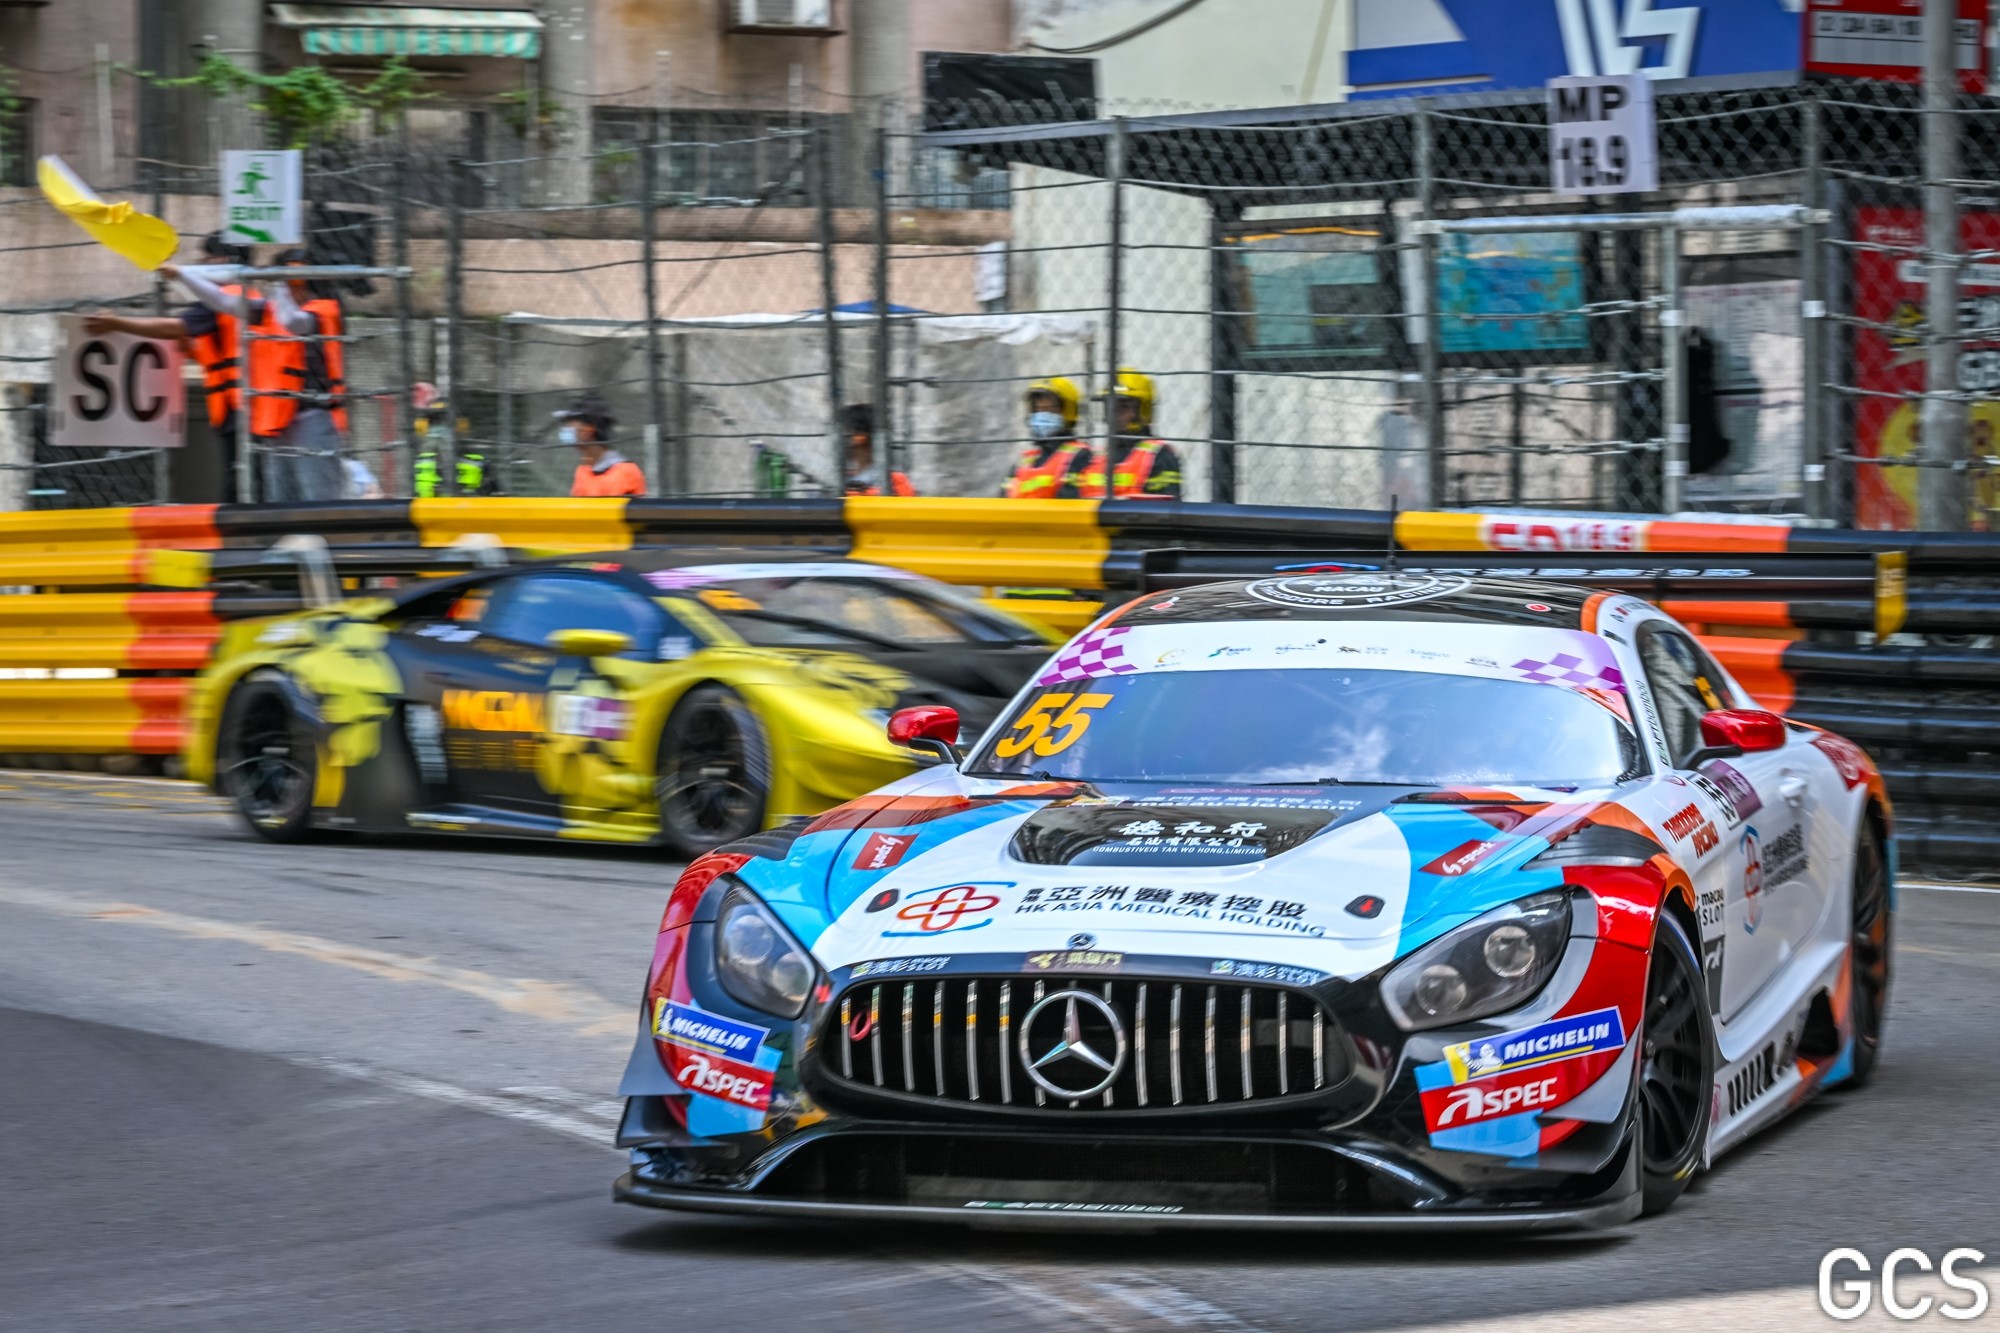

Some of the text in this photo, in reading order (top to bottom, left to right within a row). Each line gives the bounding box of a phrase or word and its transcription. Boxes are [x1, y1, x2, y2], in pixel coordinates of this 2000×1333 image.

[1553, 85, 1629, 123] MP
[71, 340, 168, 422] SC
[995, 693, 1114, 758] 55
[1014, 901, 1327, 938] HK ASIA MEDICAL HOLDING
[671, 1017, 752, 1050] MICHELIN
[1504, 1022, 1610, 1060] MICHELIN
